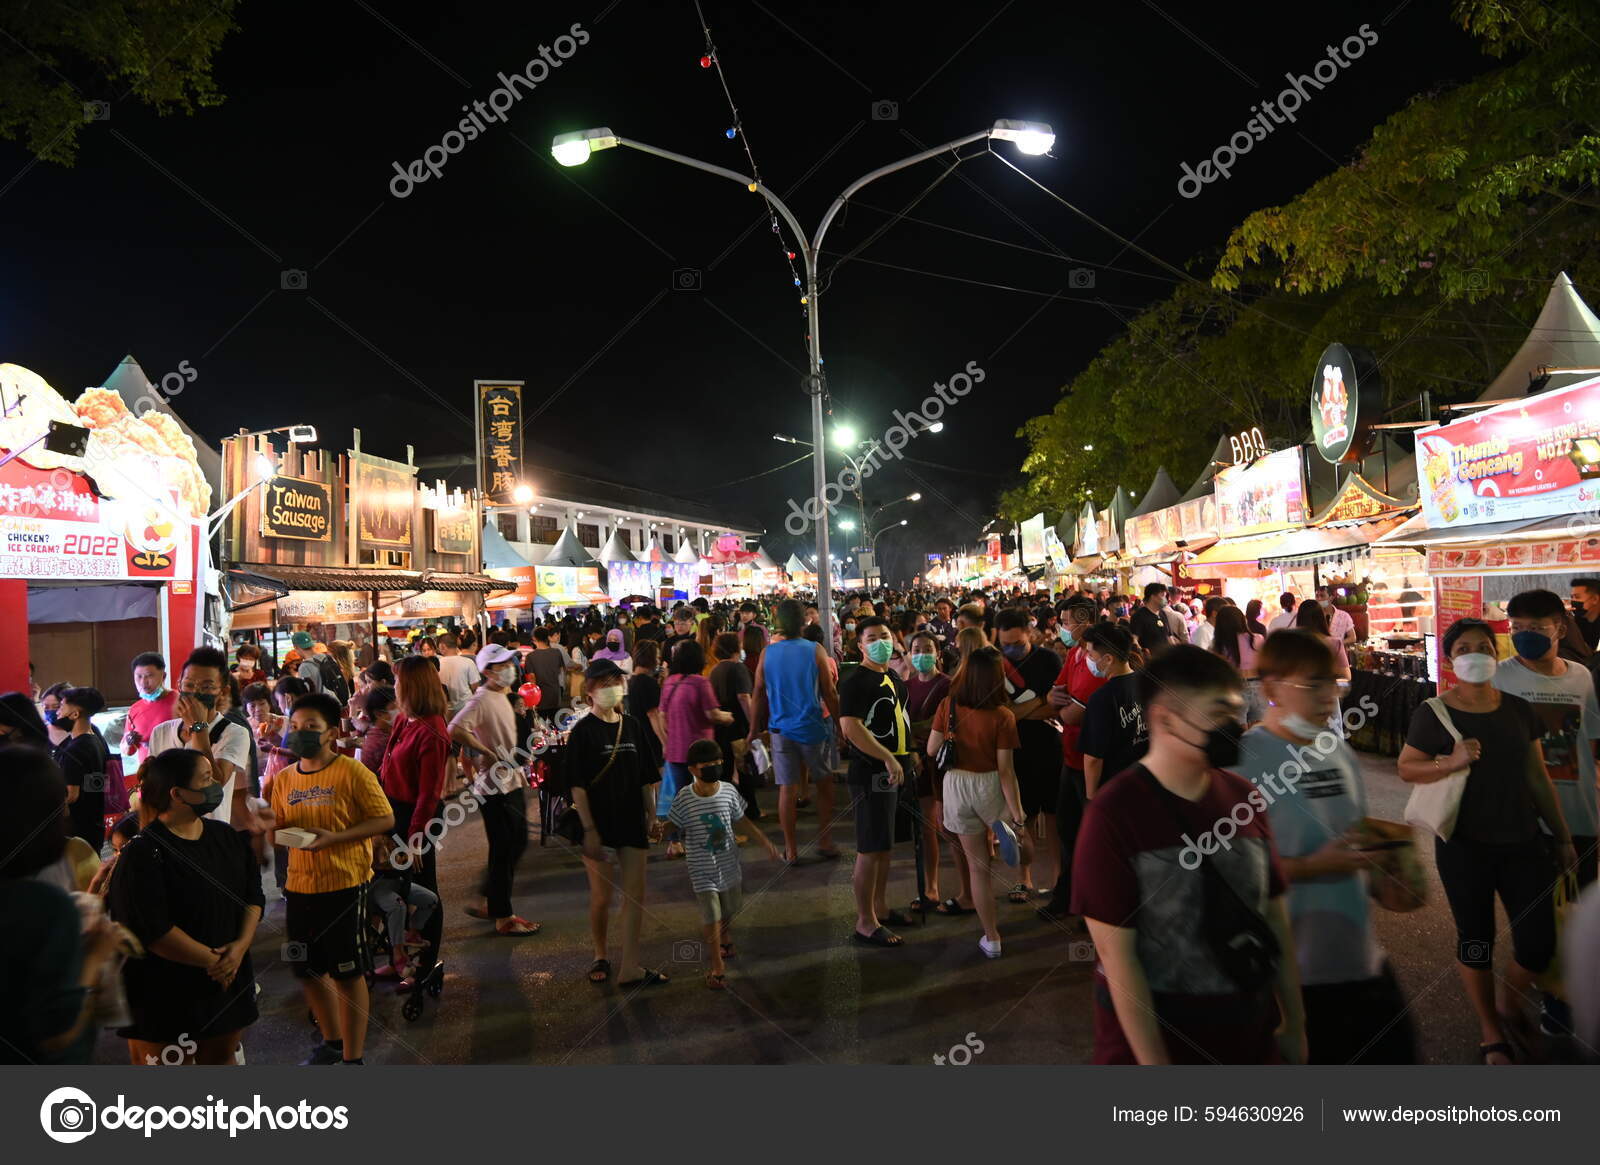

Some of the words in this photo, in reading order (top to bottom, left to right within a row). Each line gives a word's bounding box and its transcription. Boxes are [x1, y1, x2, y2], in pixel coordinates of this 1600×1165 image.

[1229, 426, 1267, 466] BBQ
[272, 485, 321, 511] Taiwan
[271, 505, 326, 533] Sausage
[7, 532, 50, 543] CHICKEN?
[7, 543, 22, 552] ICE
[25, 544, 60, 554] CREAM?
[63, 534, 119, 557] 2022
